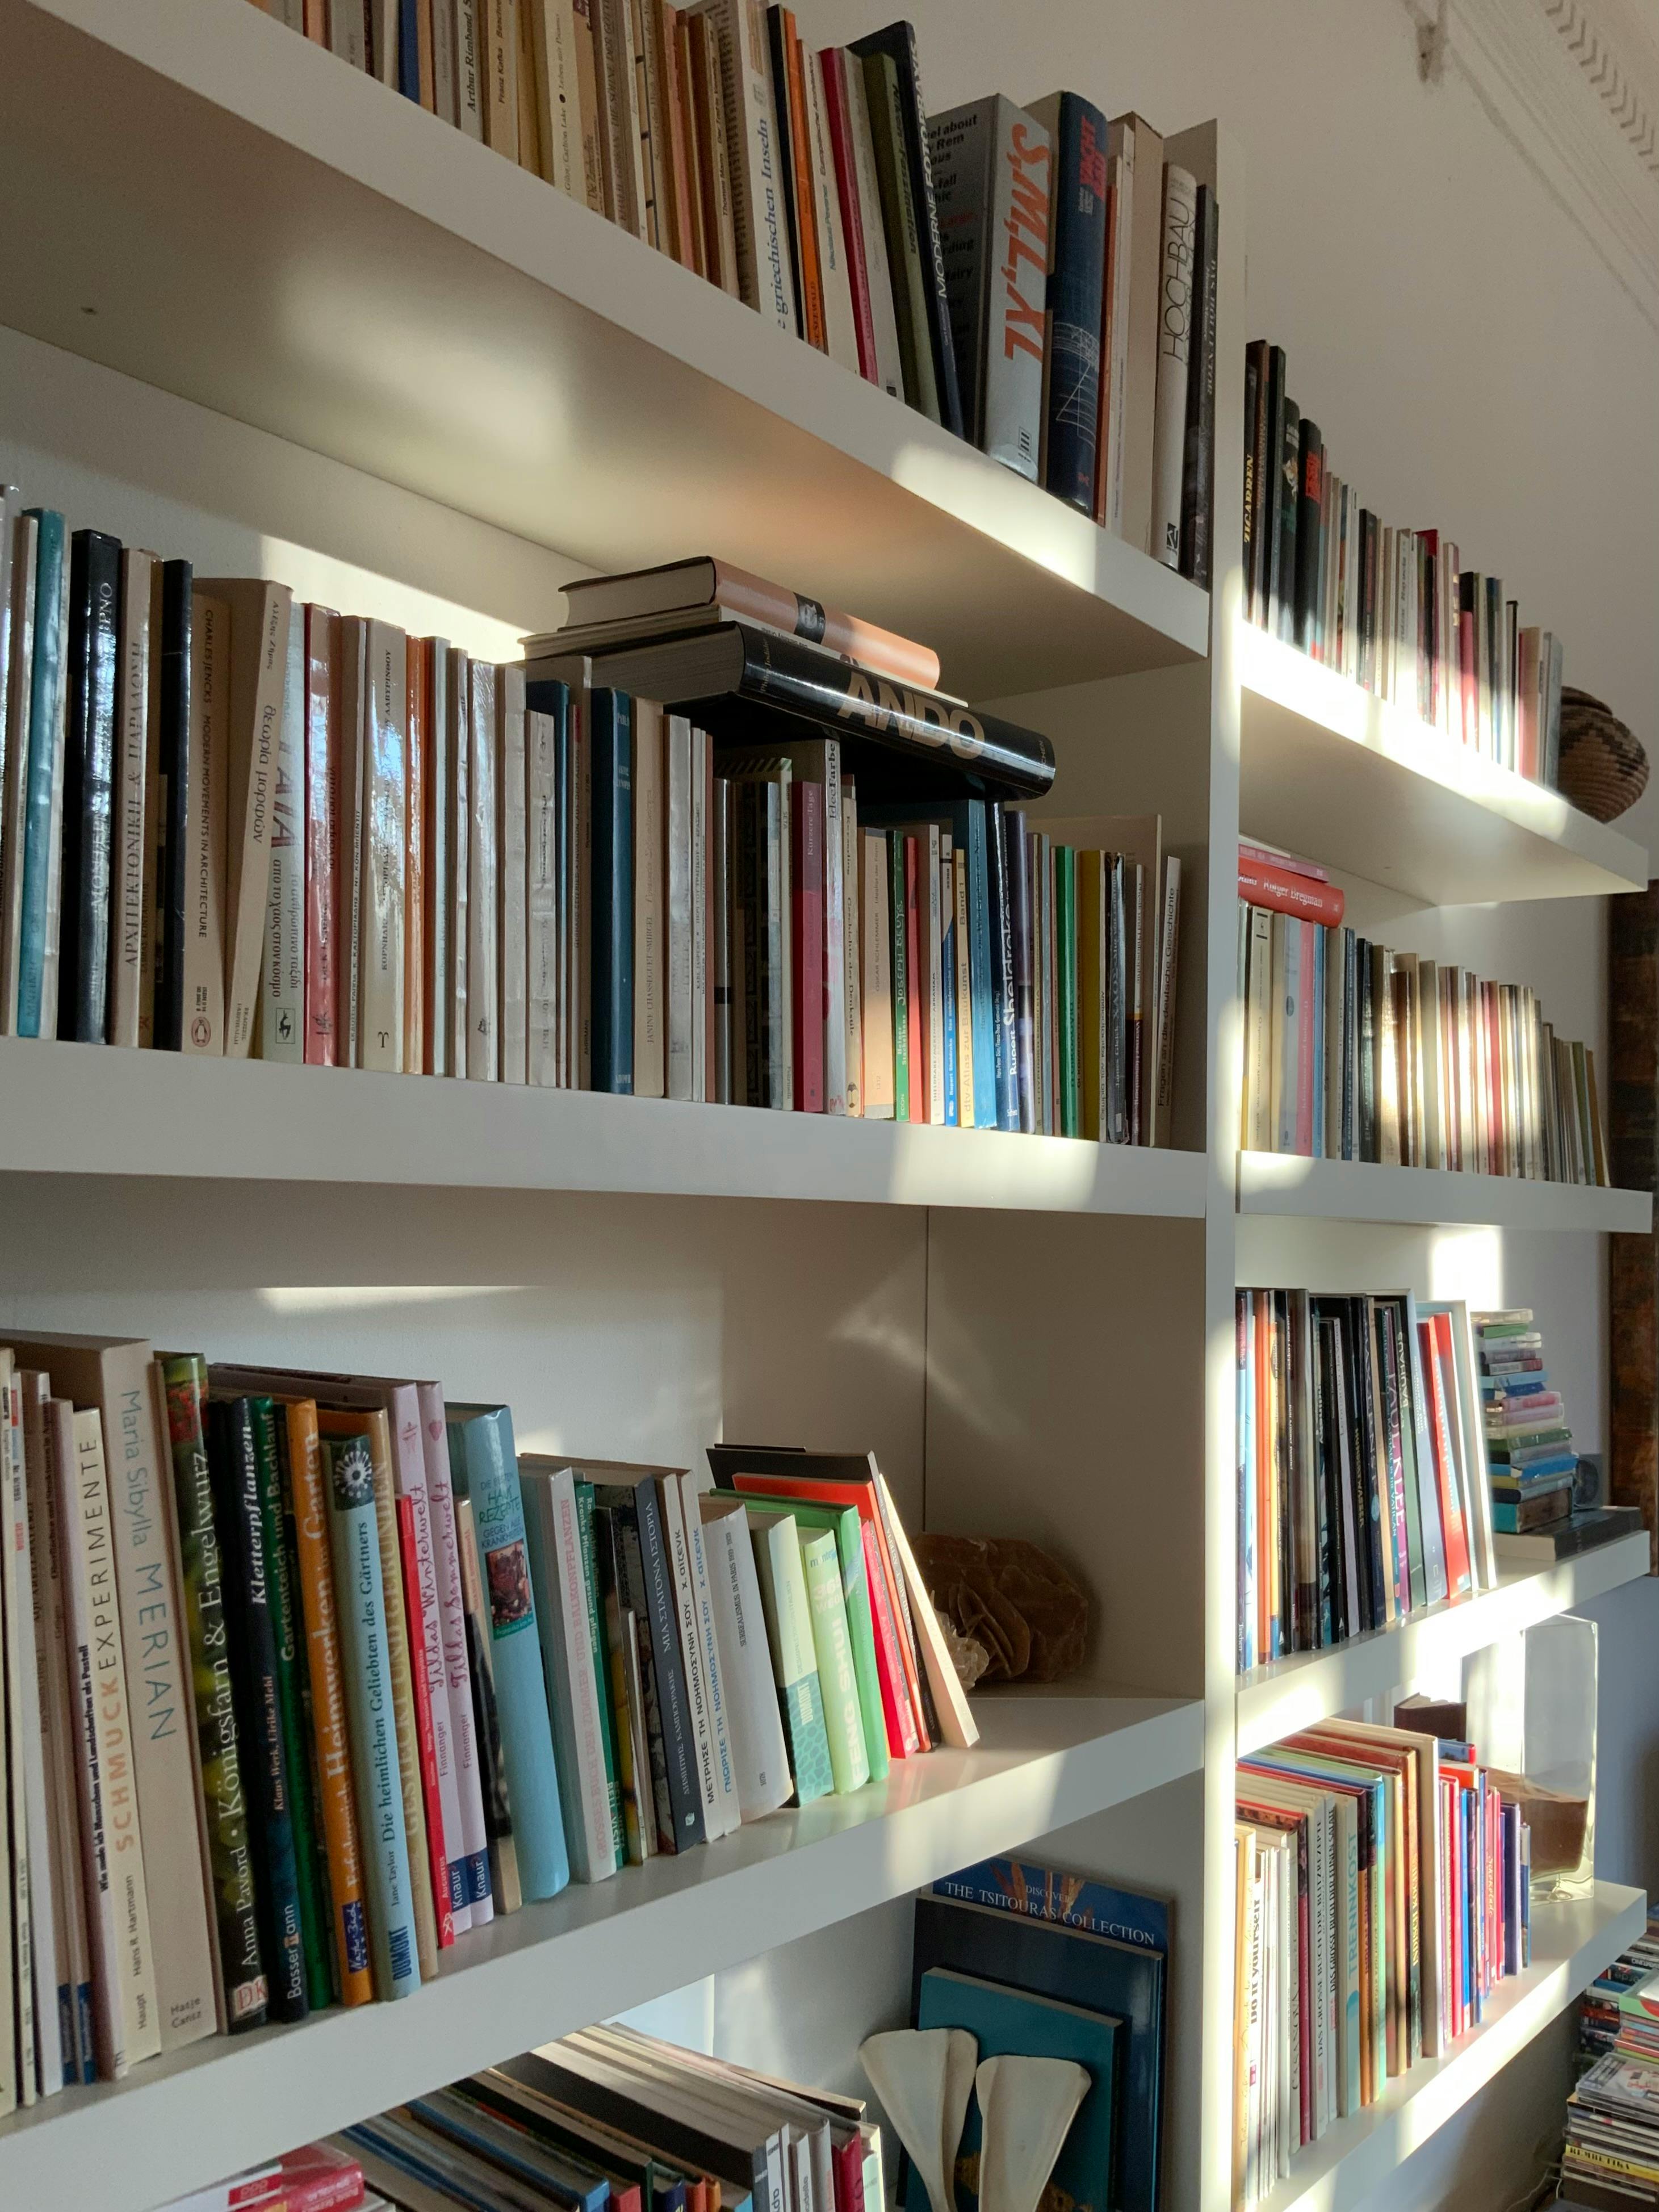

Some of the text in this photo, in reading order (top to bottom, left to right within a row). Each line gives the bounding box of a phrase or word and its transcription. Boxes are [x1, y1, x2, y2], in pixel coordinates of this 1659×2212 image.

[463, 12, 476, 112] Arthur Rimbaud
[756, 119, 789, 316] griechischen Inseln
[925, 192, 948, 298] MODERNE
[1000, 123, 1052, 361] S,M,L,XL
[1166, 198, 1193, 355] HOCHBAU
[1243, 454, 1254, 544] ZIGARREN
[837, 671, 986, 760] ANDO
[127, 772, 141, 786] &
[198, 609, 213, 939] CHARLES JENCKS MODERN MOVEMENTS IN ARCHITECTURE
[806, 790, 815, 814] Tage
[1289, 886, 1324, 908] Bregman
[896, 953, 906, 1006] JOSEPH
[960, 962, 969, 1027] Baukunst
[1157, 1063, 1167, 1107] Fragen
[1164, 887, 1175, 957] Geschichte
[303, 1431, 320, 1540] Garten
[1392, 1459, 1405, 1527] KLEE
[262, 1413, 295, 1661] Gartenteich und Bachlauf
[645, 1501, 659, 1557] ΙΣΤΟΡΙΑ
[120, 1389, 178, 1741] Maria Sibylla MERIAN
[578, 1496, 599, 1653] Kranke Pflanzen gesund pflegen
[651, 1557, 668, 1623] ΣΤΑΓΟΝΑ
[728, 1562, 747, 1647] SURREALISMUS IN PARIS
[661, 1624, 672, 1653] ΜΙΑ
[190, 1451, 259, 1968] Anna Pavord Königsfarn & Engelwurz
[262, 1675, 274, 1704] Mehl
[357, 1521, 399, 1907] Jane Taylor Die heimlichen Geliebten des Gärtners
[686, 1631, 716, 1804] ΜΕΤΡΗΣΕ ΤΗ ΝΟΗΜΟΣΥΝΗ
[704, 1626, 732, 1793] ΓΝΩΡΙΣΕ ΤΗ ΝΟΗΜΟΣΥΝΗ
[797, 1682, 814, 1725] DUMONT
[831, 1617, 863, 1782] FENG SHUI
[437, 1720, 449, 1777] Finnanger
[460, 1713, 471, 1769] Finnanger
[89, 1762, 99, 1782] und
[273, 1779, 284, 1811] Klaus
[91, 1783, 103, 1830] Menschen
[451, 1870, 463, 1911] Knaur
[475, 1859, 485, 1899] Knaur
[1347, 1832, 1358, 1973] TRENNKOST
[127, 1874, 143, 1978] Hans Hartmann
[945, 1880, 1155, 1946] THE TSITOURAS COLLECTION
[1315, 1909, 1325, 1935] DER
[1411, 1911, 1420, 1967] INDISCH
[388, 1924, 412, 1981] DUMONT
[1315, 1940, 1325, 1974] BUCH
[1329, 1933, 1337, 1972] GROSSE
[137, 1993, 147, 2030] Haupt
[235, 1983, 266, 2010] DK
[1316, 1978, 1326, 2031] GROSSE
[1329, 1974, 1338, 1994] DAS
[1316, 2035, 1326, 2058] DAS
